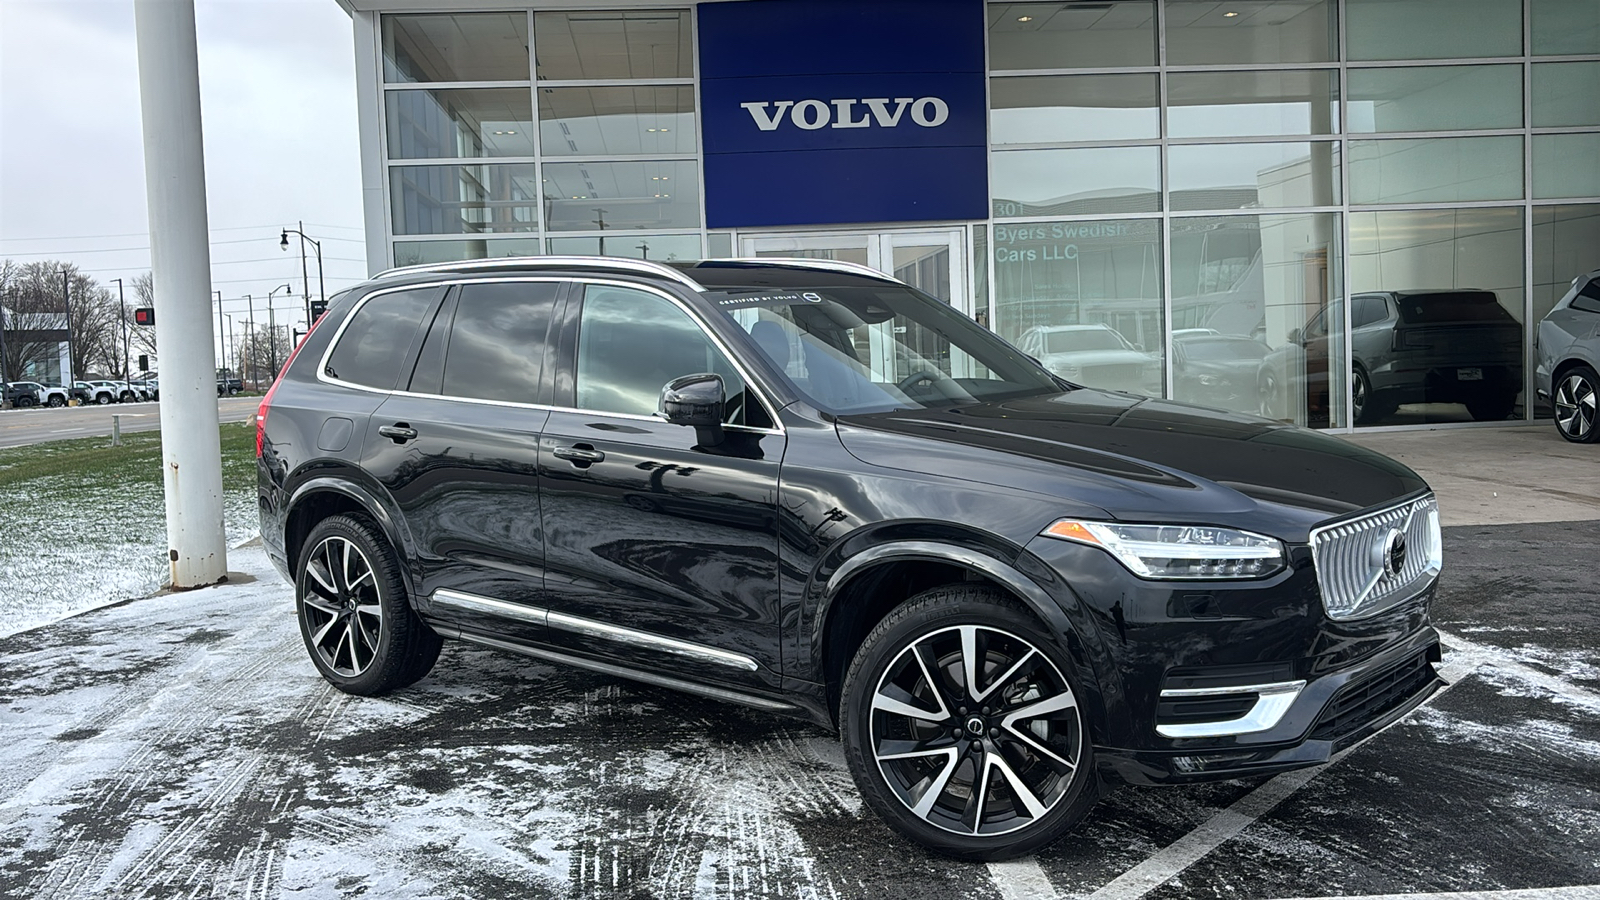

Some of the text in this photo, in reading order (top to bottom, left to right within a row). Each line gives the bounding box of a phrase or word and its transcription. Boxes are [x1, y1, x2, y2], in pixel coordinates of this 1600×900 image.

[740, 97, 949, 131] VOLVO
[995, 203, 1024, 217] 301
[995, 223, 1127, 243] Byers Swedish
[995, 244, 1079, 262] Cars LLC
[719, 297, 760, 305] CERTIFIED
